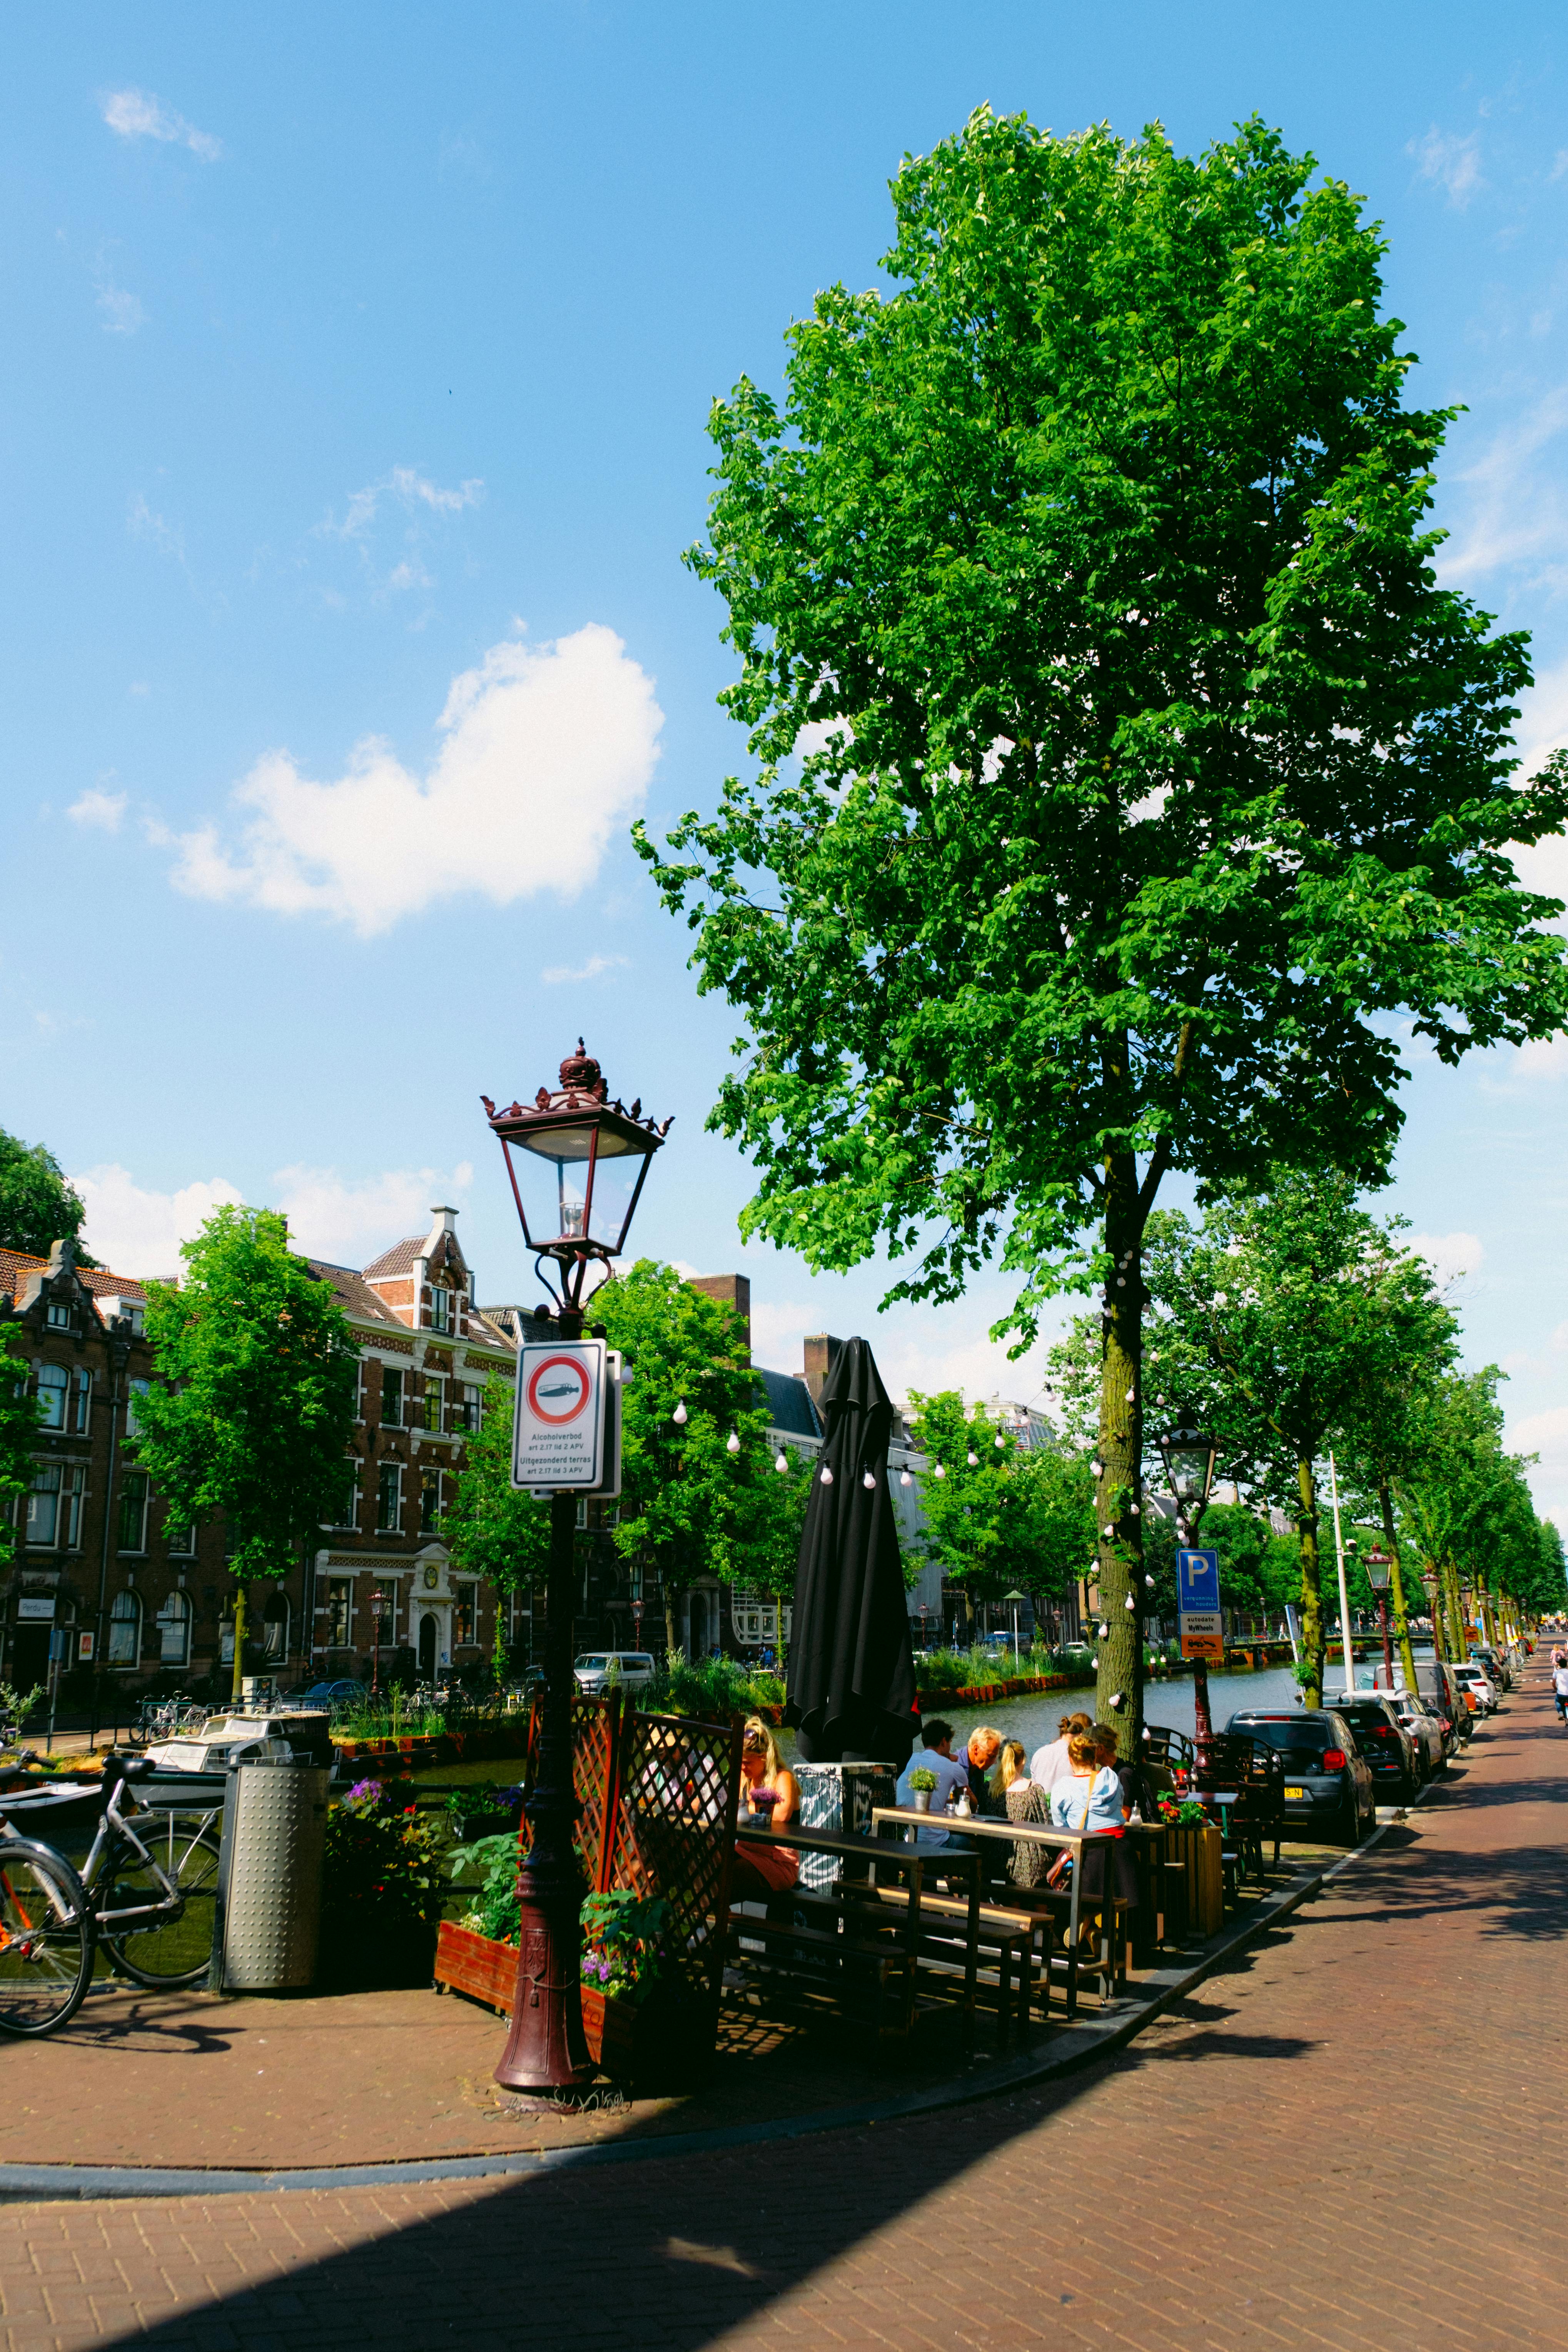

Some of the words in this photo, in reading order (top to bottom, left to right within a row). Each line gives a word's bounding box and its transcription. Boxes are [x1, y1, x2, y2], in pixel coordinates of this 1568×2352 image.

[532, 1432, 582, 1440] Alcoholverbod
[520, 1457, 567, 1466] Uitgezonderd
[1188, 1555, 1209, 1586] P
[23, 1603, 40, 1612] Perdu
